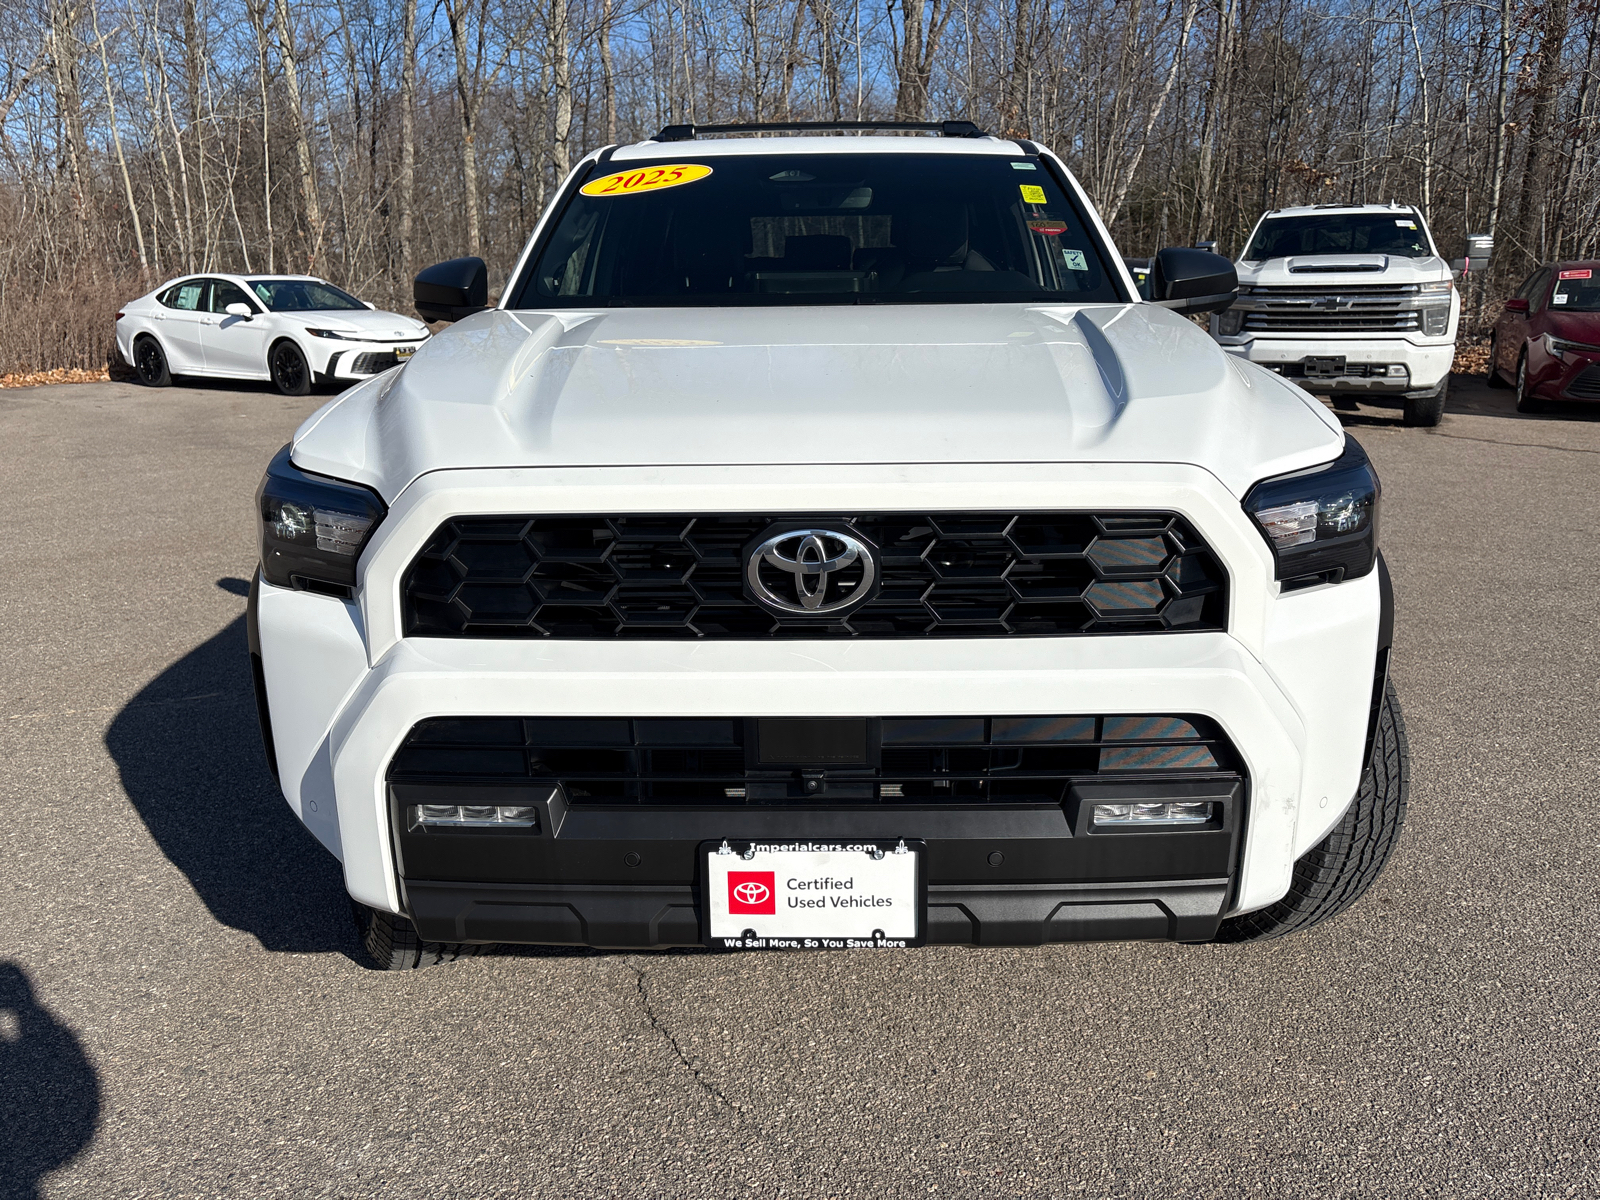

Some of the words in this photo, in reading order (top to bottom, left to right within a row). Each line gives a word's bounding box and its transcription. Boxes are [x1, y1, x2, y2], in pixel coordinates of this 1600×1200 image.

[600, 167, 688, 193] 2025
[750, 843, 877, 853] Imperialcars.com
[787, 877, 853, 890] Certified
[787, 896, 826, 908] Used
[830, 895, 892, 908] Vehicles
[724, 939, 743, 948] We
[745, 939, 766, 948] Sell
[769, 939, 801, 949] More,
[804, 939, 818, 948] So
[822, 939, 844, 948] You
[847, 939, 876, 948] Save
[877, 939, 906, 948] More
